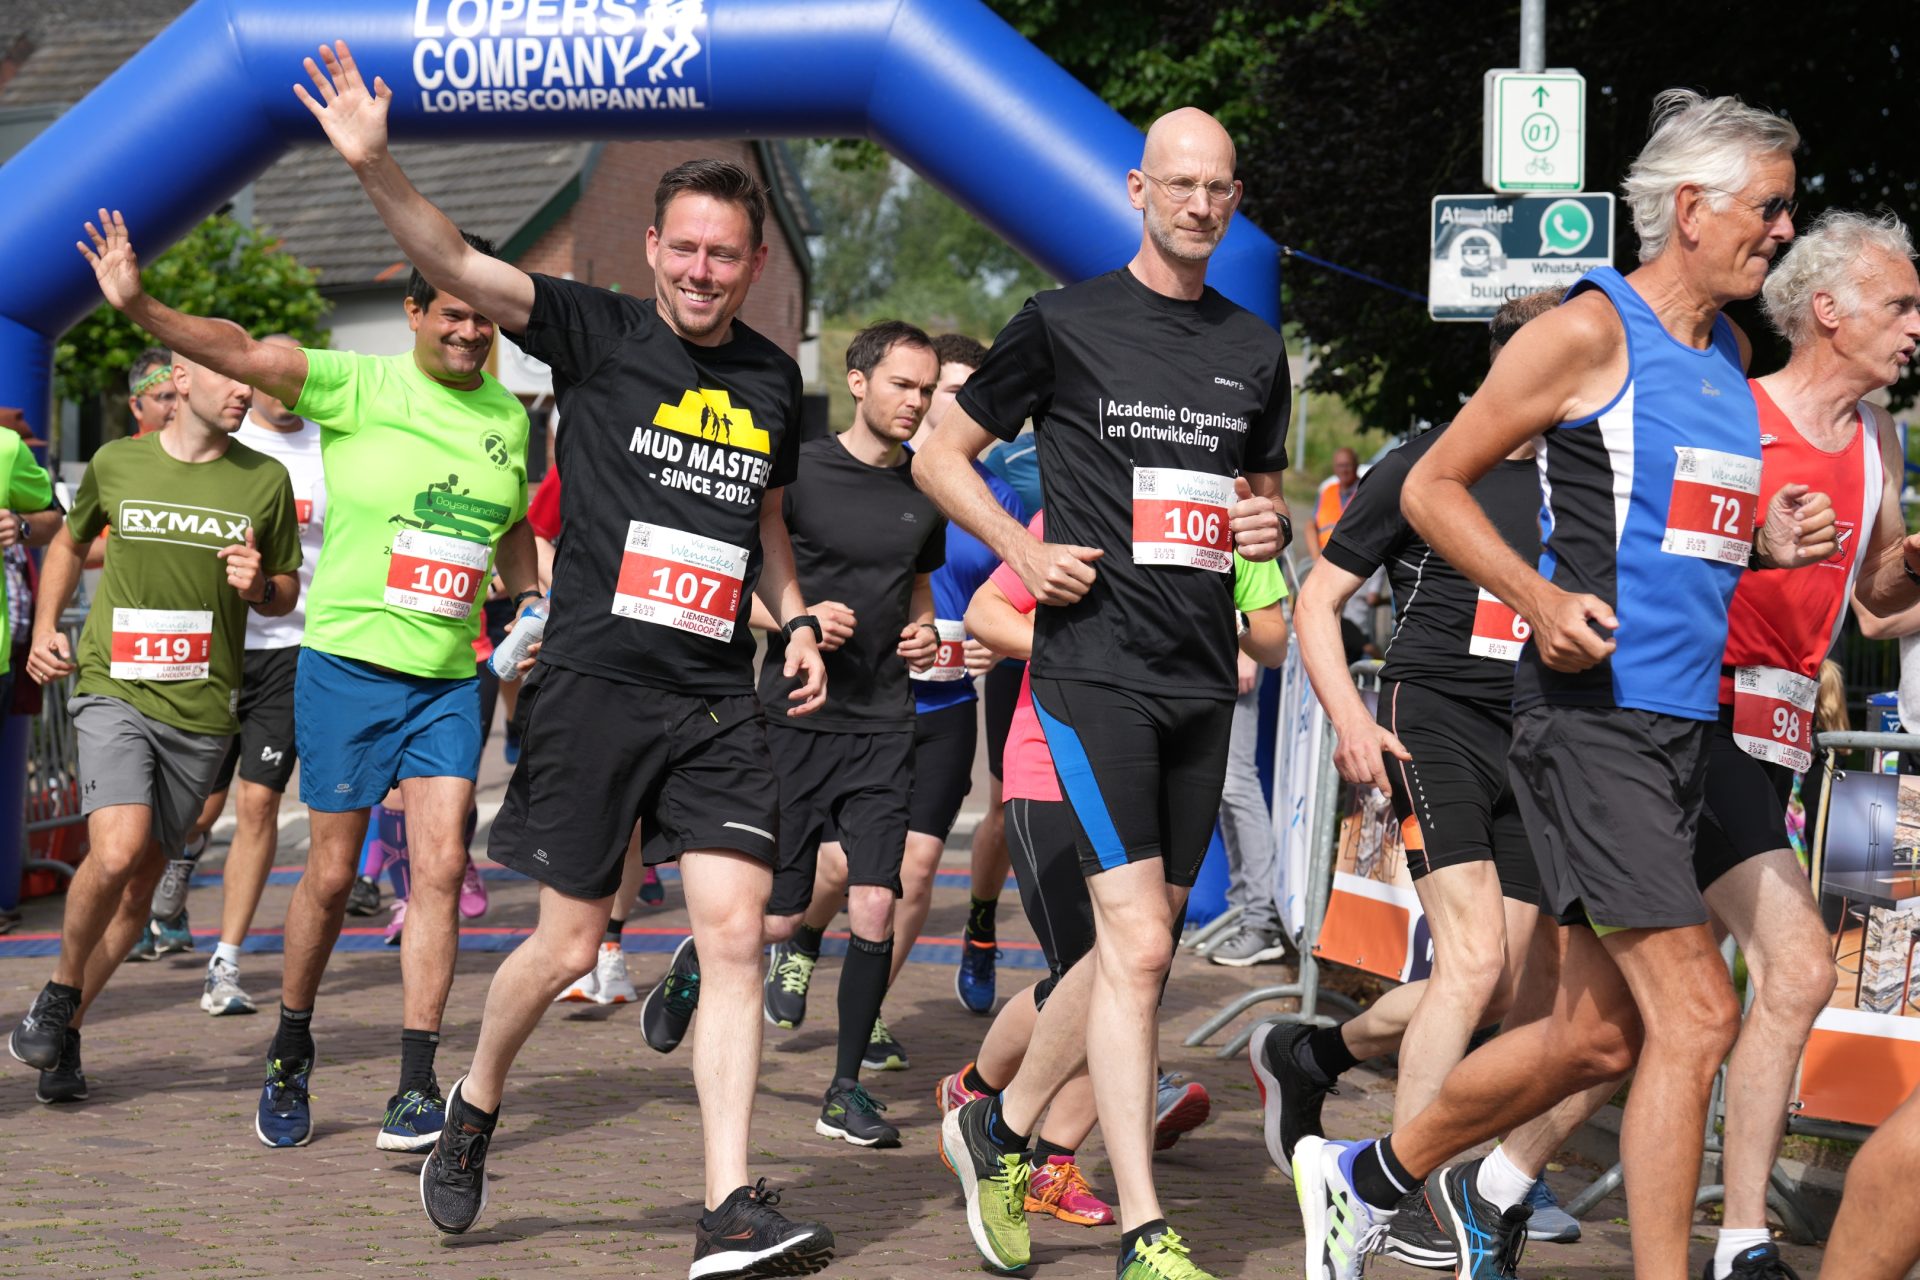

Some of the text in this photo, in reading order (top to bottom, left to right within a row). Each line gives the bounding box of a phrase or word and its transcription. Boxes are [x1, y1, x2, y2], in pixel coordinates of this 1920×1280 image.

[413, 0, 637, 38] LOPERS
[413, 36, 634, 89] COMPANY
[420, 86, 705, 113] LOPERSCOMPANY.NL
[1528, 124, 1552, 142] 01
[1214, 376, 1239, 388] CRAFT
[1107, 400, 1248, 434] Academie Organisatie
[1107, 421, 1219, 453] en Ontwikkeling
[629, 426, 773, 489] MUD MASTERS
[660, 467, 711, 496] SINCE
[714, 482, 751, 506] 2012
[1164, 507, 1220, 545] 106
[1710, 494, 1740, 534] 72
[411, 564, 470, 599] 100
[648, 566, 721, 610] 107
[632, 607, 655, 618] 2022
[672, 617, 715, 636] LANDLOOP
[681, 610, 718, 627] LIEMERSE
[1512, 613, 1530, 640] 6
[133, 637, 191, 663] 119
[1772, 707, 1800, 743] 98
[1748, 746, 1768, 756] 2022
